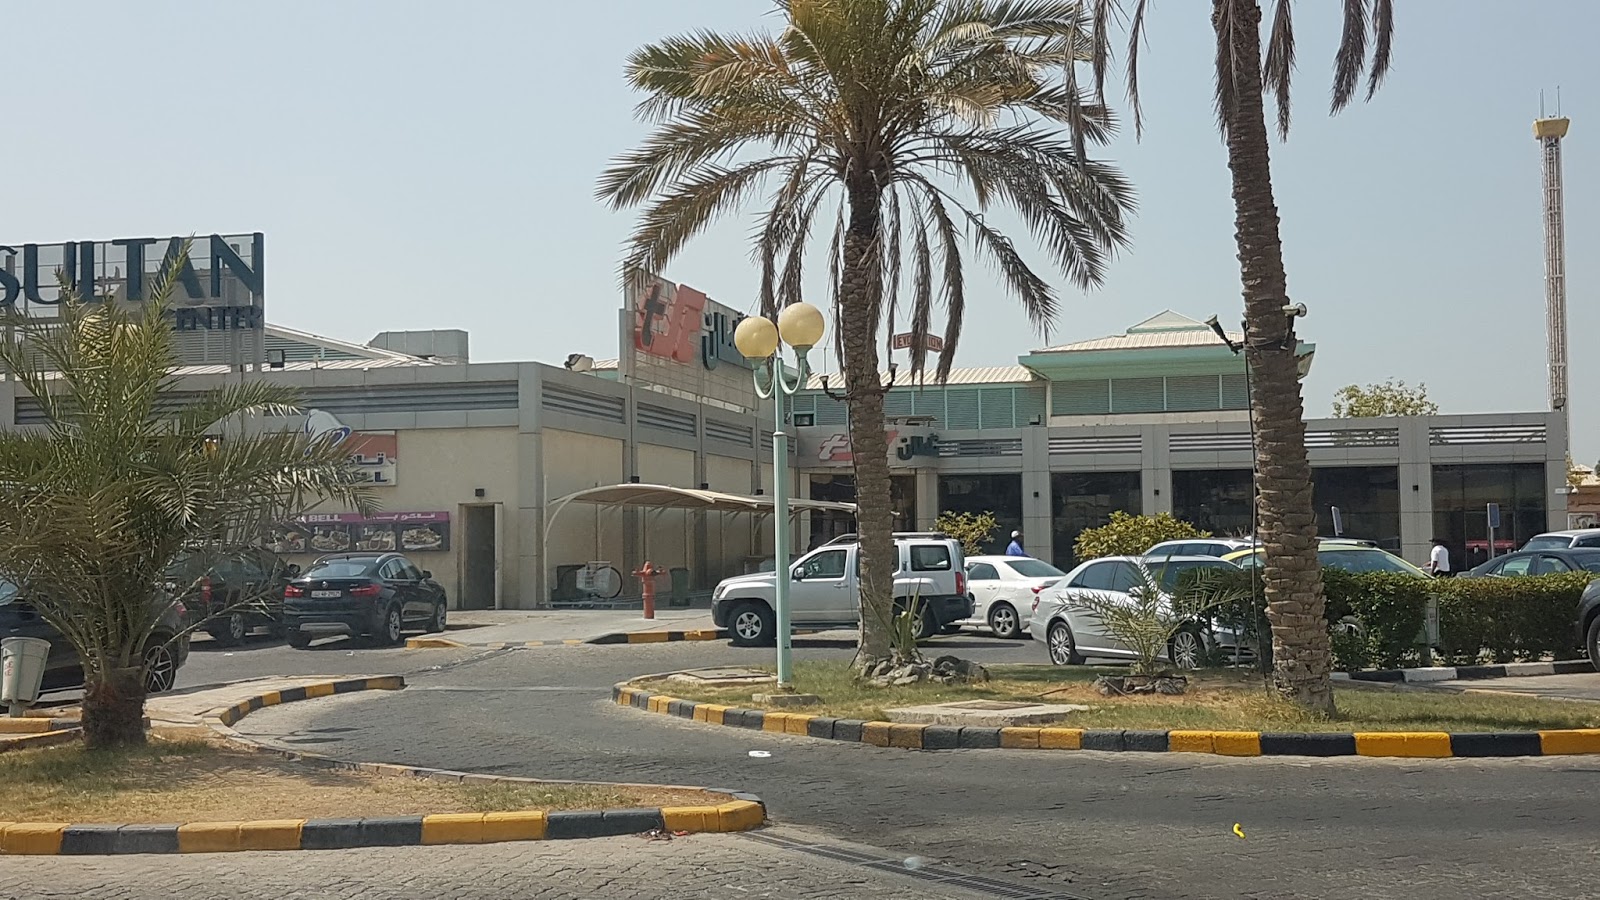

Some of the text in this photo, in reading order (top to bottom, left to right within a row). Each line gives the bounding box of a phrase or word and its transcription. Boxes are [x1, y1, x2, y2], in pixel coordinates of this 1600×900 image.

[164, 305, 263, 331] ENTER
[897, 334, 942, 350] EVOION
[308, 514, 342, 522] BELL
